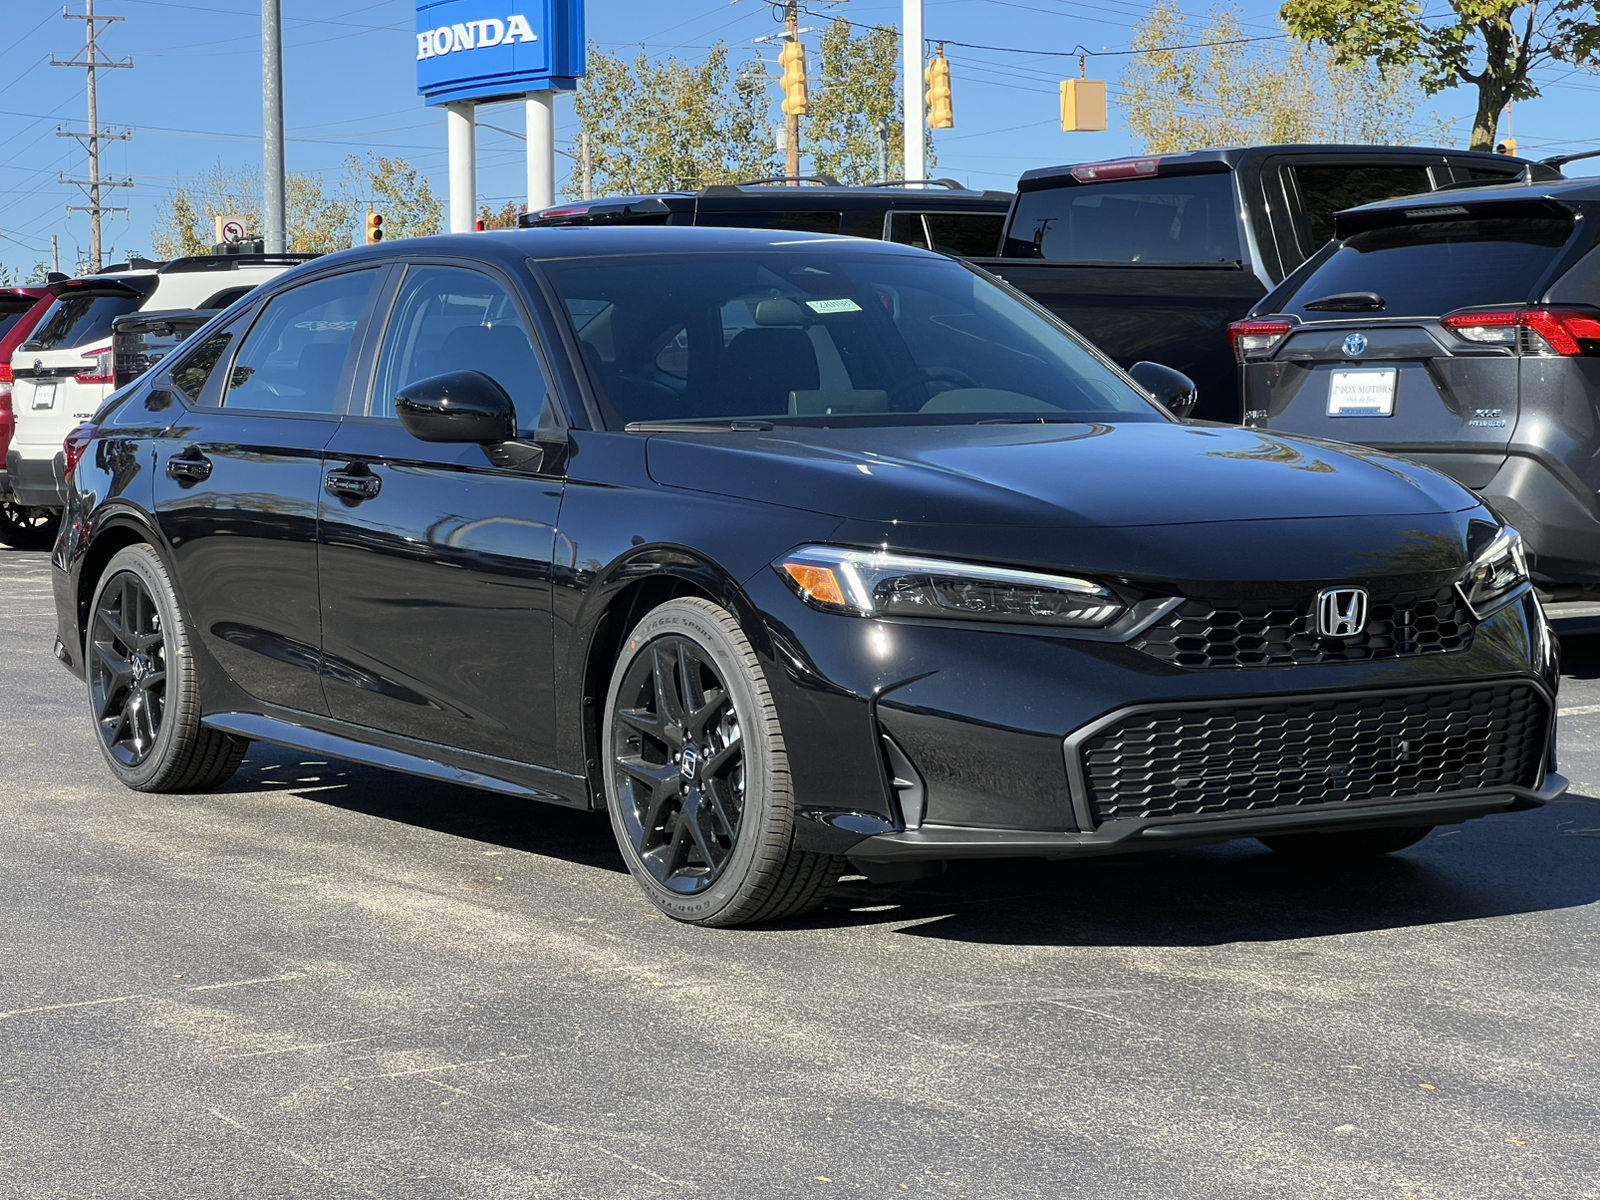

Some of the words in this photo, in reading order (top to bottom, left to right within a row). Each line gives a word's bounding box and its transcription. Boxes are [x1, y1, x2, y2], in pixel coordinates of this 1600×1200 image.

[416, 15, 538, 60] HONDA
[1341, 385, 1356, 394] FOX
[1357, 385, 1393, 394] MOTORS
[646, 616, 680, 632] EAGLE
[682, 618, 714, 641] SPORT
